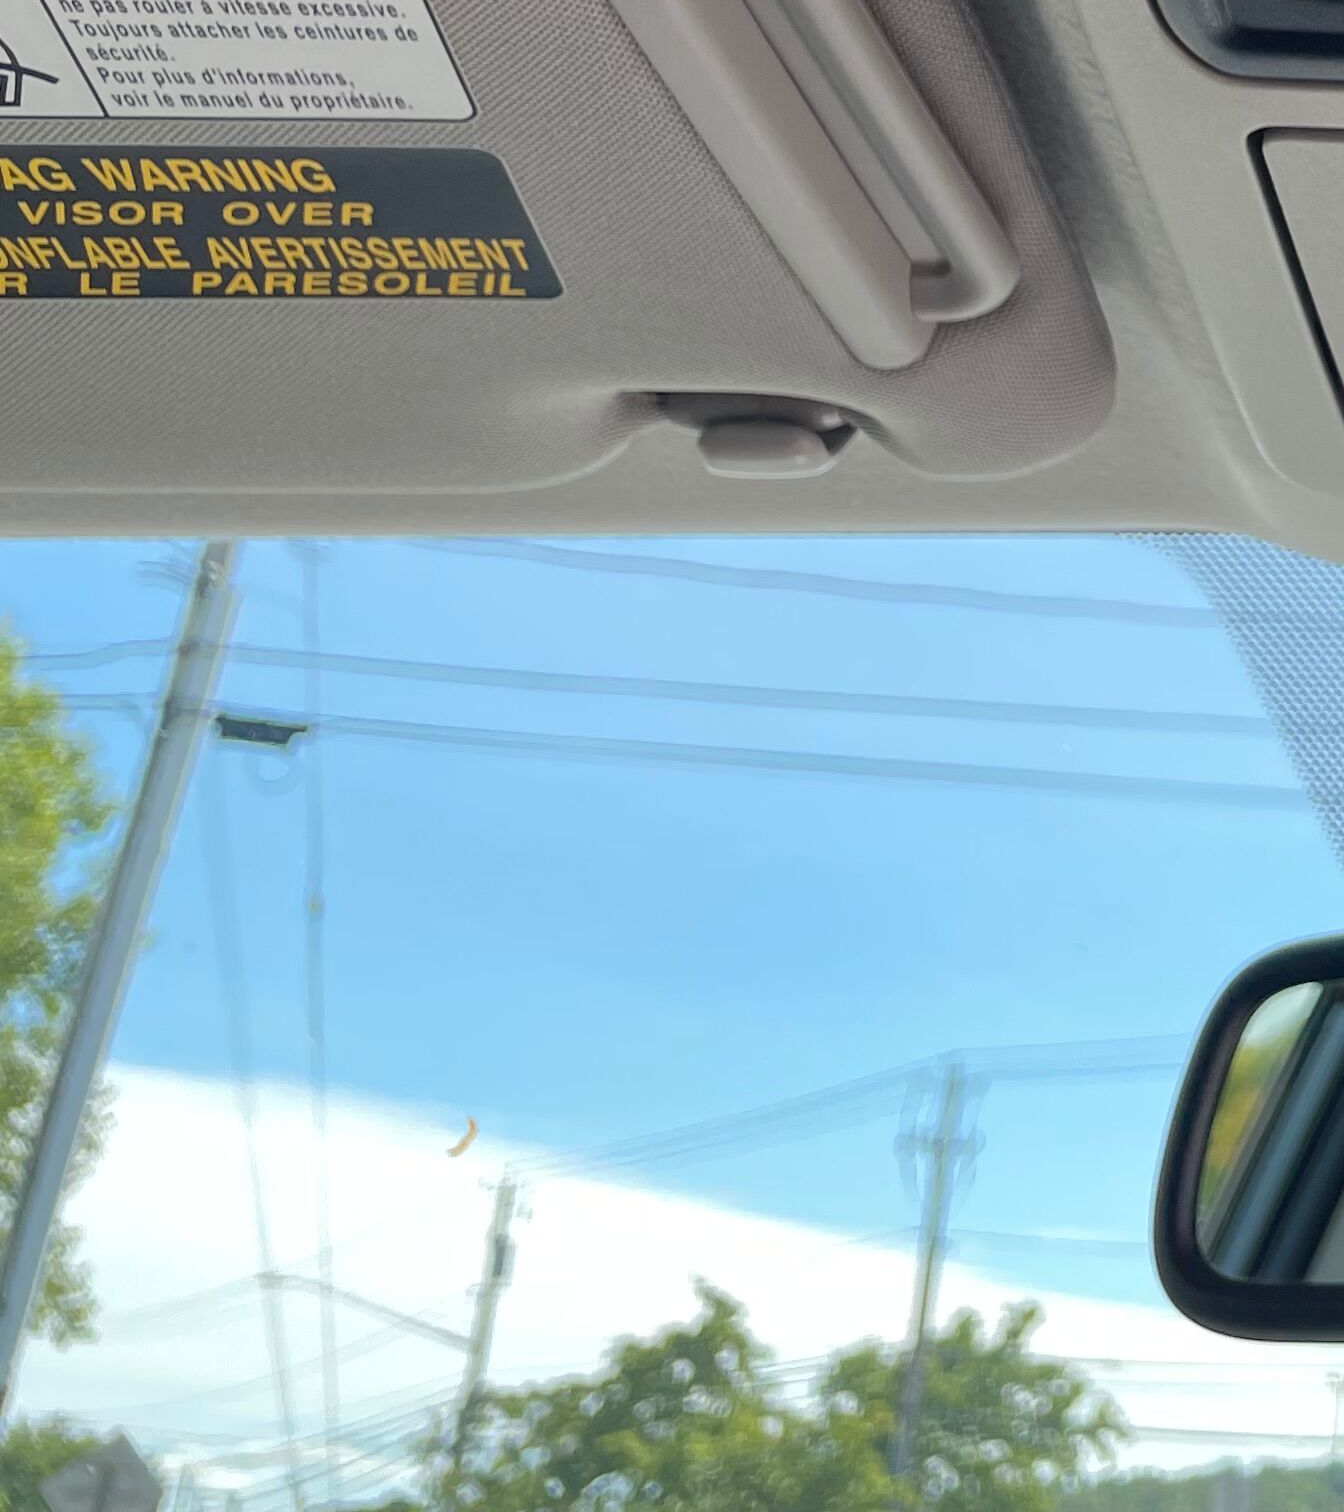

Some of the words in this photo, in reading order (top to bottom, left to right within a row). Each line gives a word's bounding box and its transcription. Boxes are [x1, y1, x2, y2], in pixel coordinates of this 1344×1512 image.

[89, 0, 128, 17] pas
[297, 0, 407, 19] excessive.
[69, 19, 163, 41] Toujours
[167, 20, 250, 39] attacher
[255, 21, 288, 39] les
[293, 23, 389, 41] ceintures
[394, 24, 419, 42] de
[96, 66, 146, 84] Pour
[151, 68, 197, 88] plus
[111, 90, 151, 108] voir
[153, 90, 176, 108] le
[180, 91, 255, 109] manuel
[259, 92, 285, 110] du
[80, 157, 337, 193] WARNING
[17, 200, 185, 227] VISOR
[222, 200, 375, 227] OVER
[0, 236, 191, 270] NFLABLE
[206, 237, 530, 271] AVERTISSEMENT
[79, 271, 141, 296] LE
[192, 271, 527, 297] PARESOLEIL
